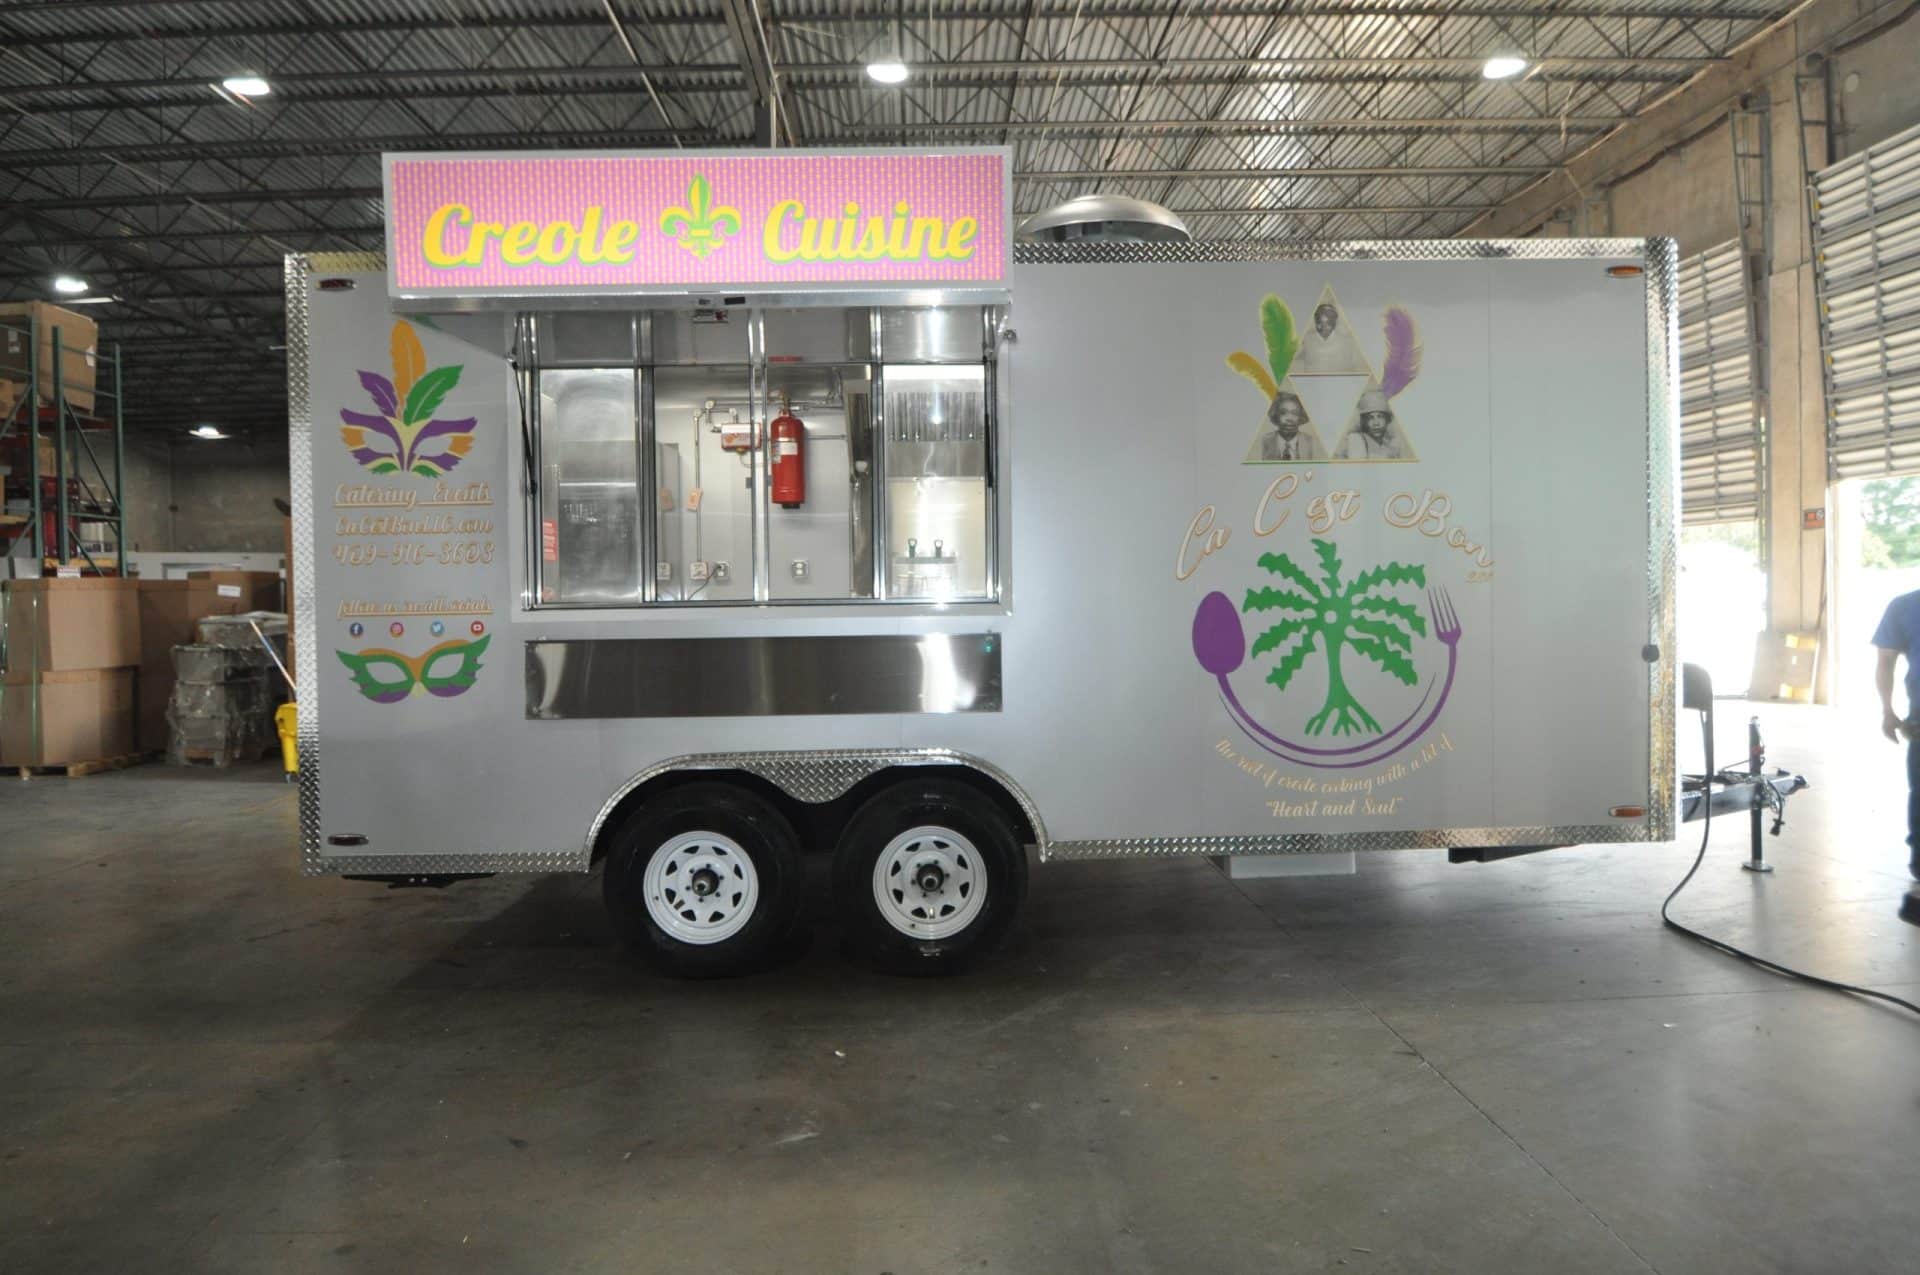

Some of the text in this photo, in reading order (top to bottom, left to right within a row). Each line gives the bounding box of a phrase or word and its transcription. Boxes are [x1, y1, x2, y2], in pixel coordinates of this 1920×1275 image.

[423, 199, 978, 268] Creole Cuisine
[335, 480, 490, 511] Catering Events
[1253, 471, 1361, 537] C'est
[1383, 488, 1494, 568] Bon
[1321, 777, 1373, 794] cooking
[1376, 763, 1408, 786] with
[1321, 799, 1355, 816] and
